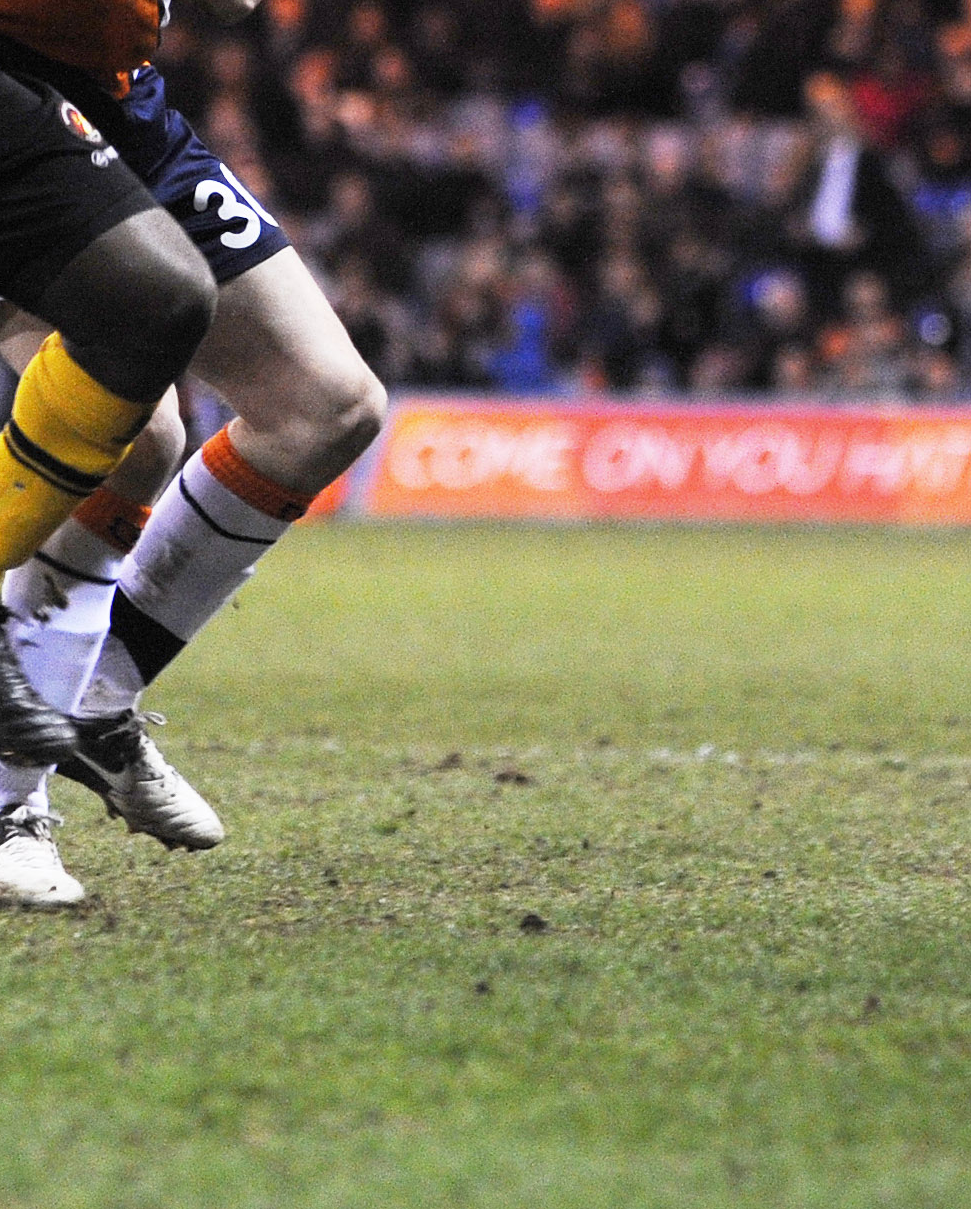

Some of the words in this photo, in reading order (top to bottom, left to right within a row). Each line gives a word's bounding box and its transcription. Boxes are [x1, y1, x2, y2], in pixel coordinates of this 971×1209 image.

[385, 421, 576, 491] COME
[580, 421, 690, 493] ON
[700, 421, 844, 494] YOU
